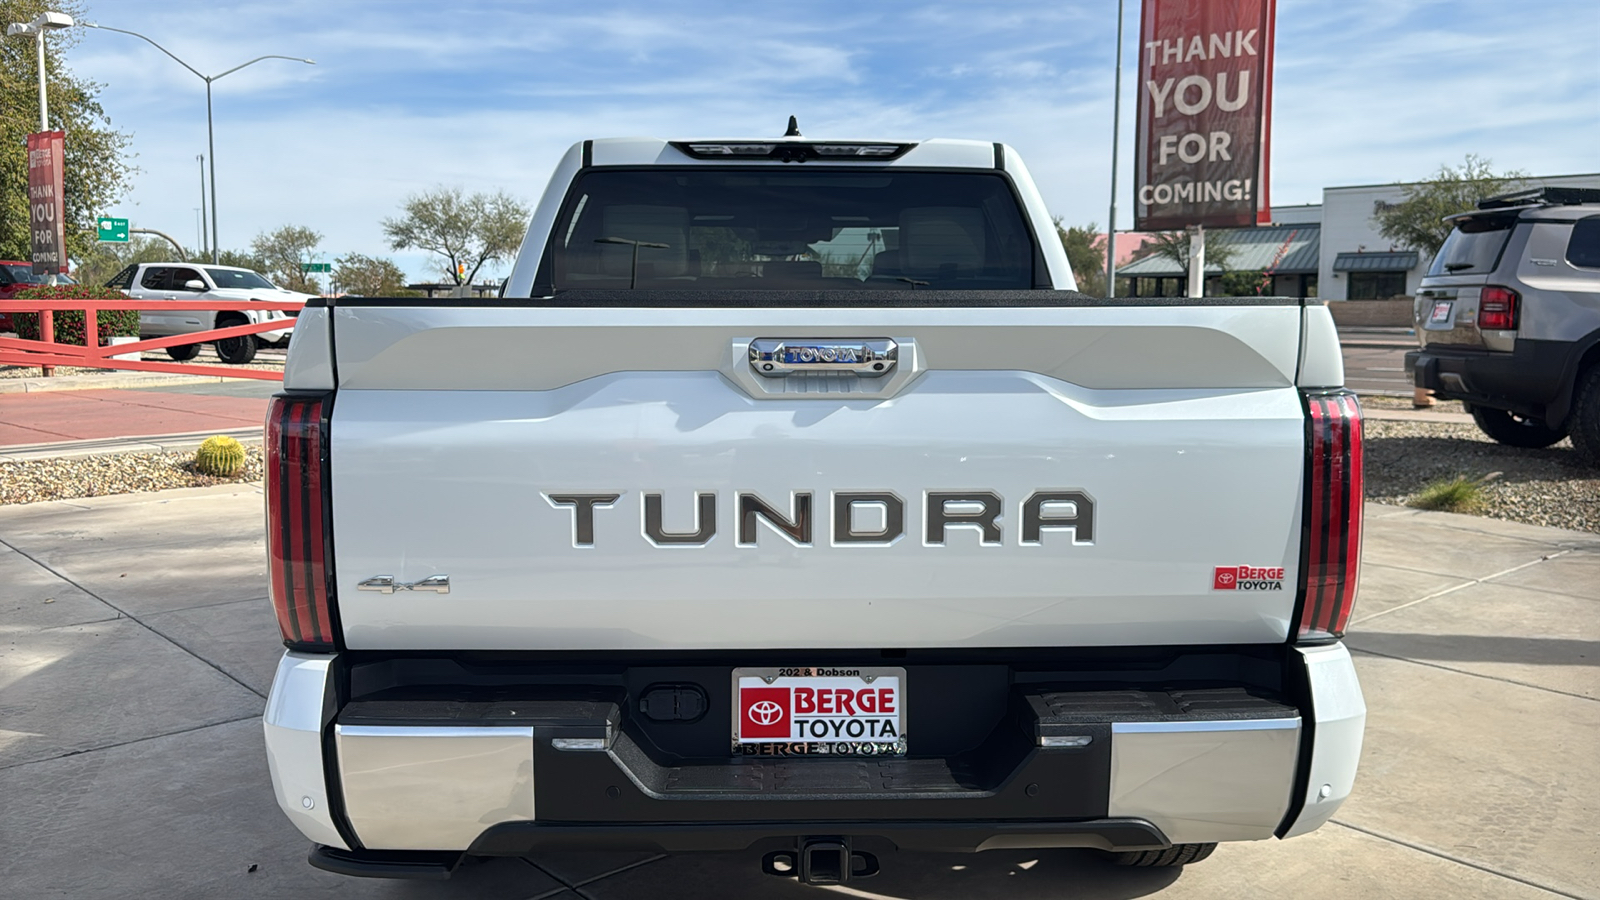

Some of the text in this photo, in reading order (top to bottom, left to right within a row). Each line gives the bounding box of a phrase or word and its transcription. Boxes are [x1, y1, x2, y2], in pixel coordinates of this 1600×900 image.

[1146, 29, 1258, 67] THANK
[1147, 70, 1250, 119] YOU
[1159, 131, 1232, 166] FOR
[30, 185, 54, 199] THANK
[1139, 178, 1252, 206] COMING!
[31, 203, 54, 223] YOU
[35, 229, 53, 245] FOR
[33, 251, 58, 263] COMING!
[789, 347, 858, 363] TOYOTA
[541, 489, 1098, 548] TUNDRA
[1237, 581, 1282, 590] TOYOTA
[779, 668, 860, 677] 202 & Dobson
[794, 687, 895, 716] BERGE
[794, 719, 897, 738] TOYOTA
[743, 742, 819, 756] BERGE
